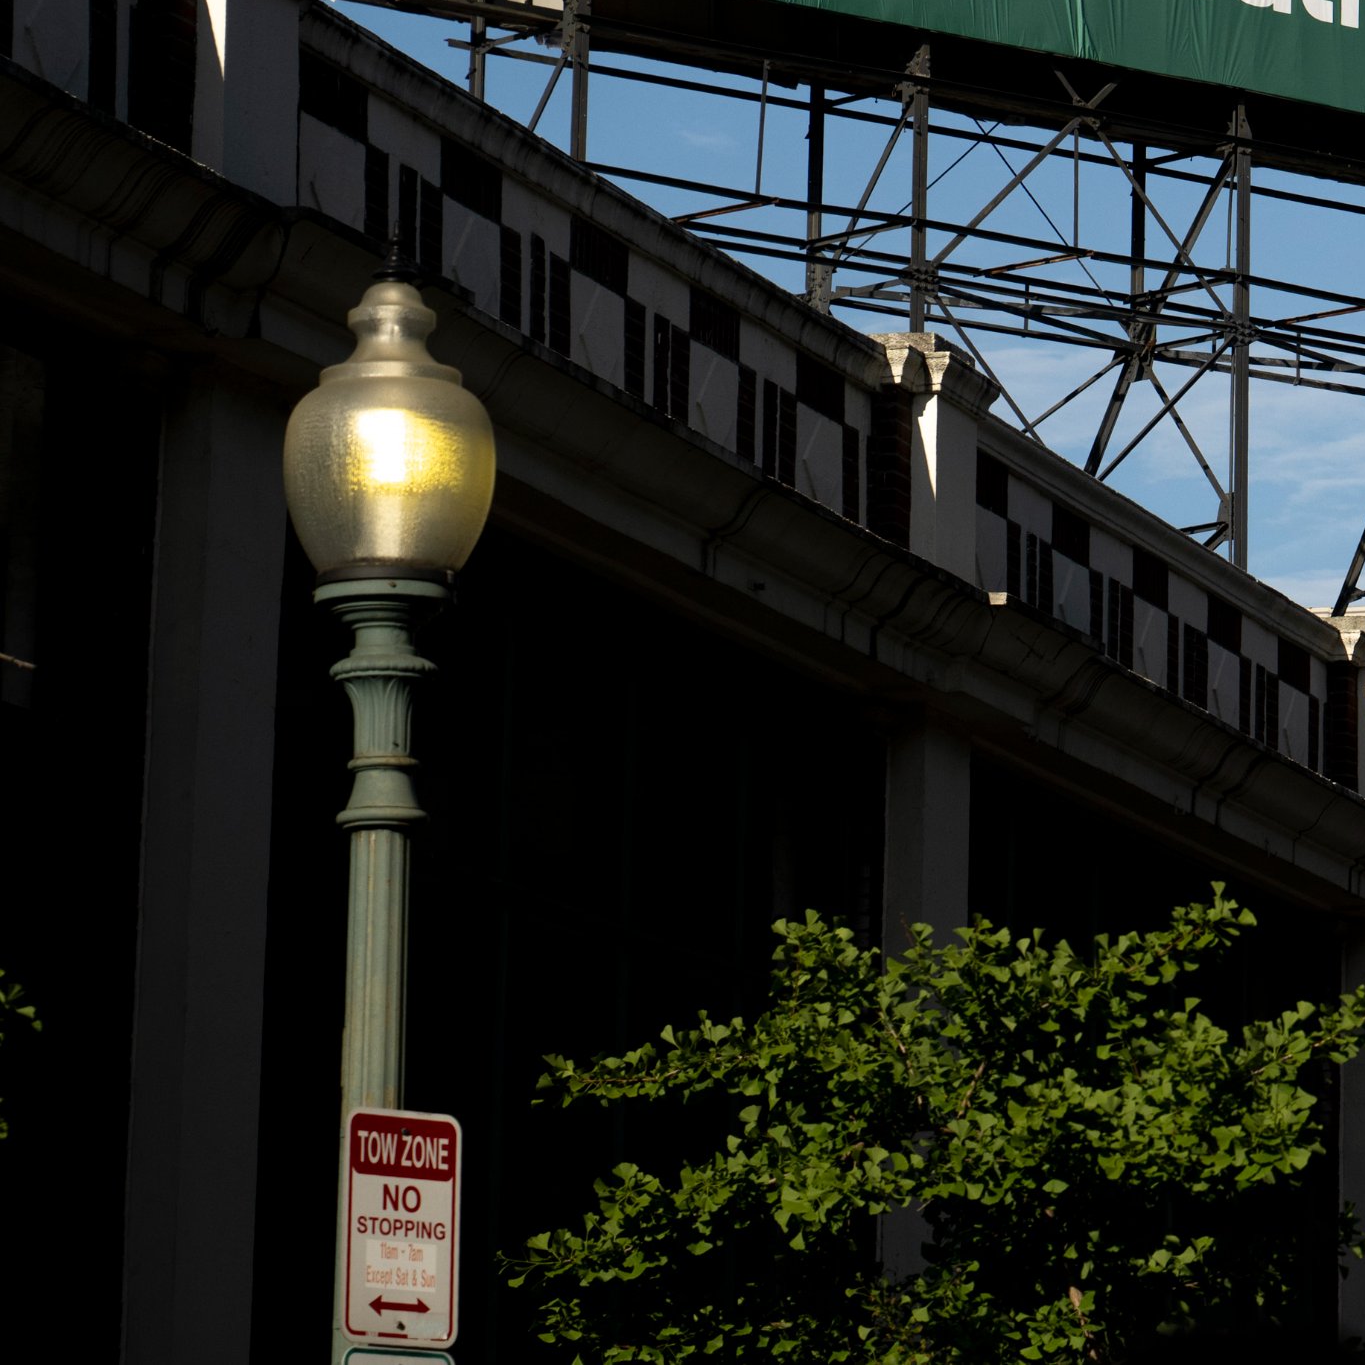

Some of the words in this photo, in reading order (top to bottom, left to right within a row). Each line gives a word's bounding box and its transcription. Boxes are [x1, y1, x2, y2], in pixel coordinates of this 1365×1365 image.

[357, 1130, 399, 1166] TOW
[401, 1135, 449, 1171] ZONE
[382, 1183, 421, 1213] NO
[357, 1215, 446, 1240] STOPPING
[366, 1265, 393, 1289] Except
